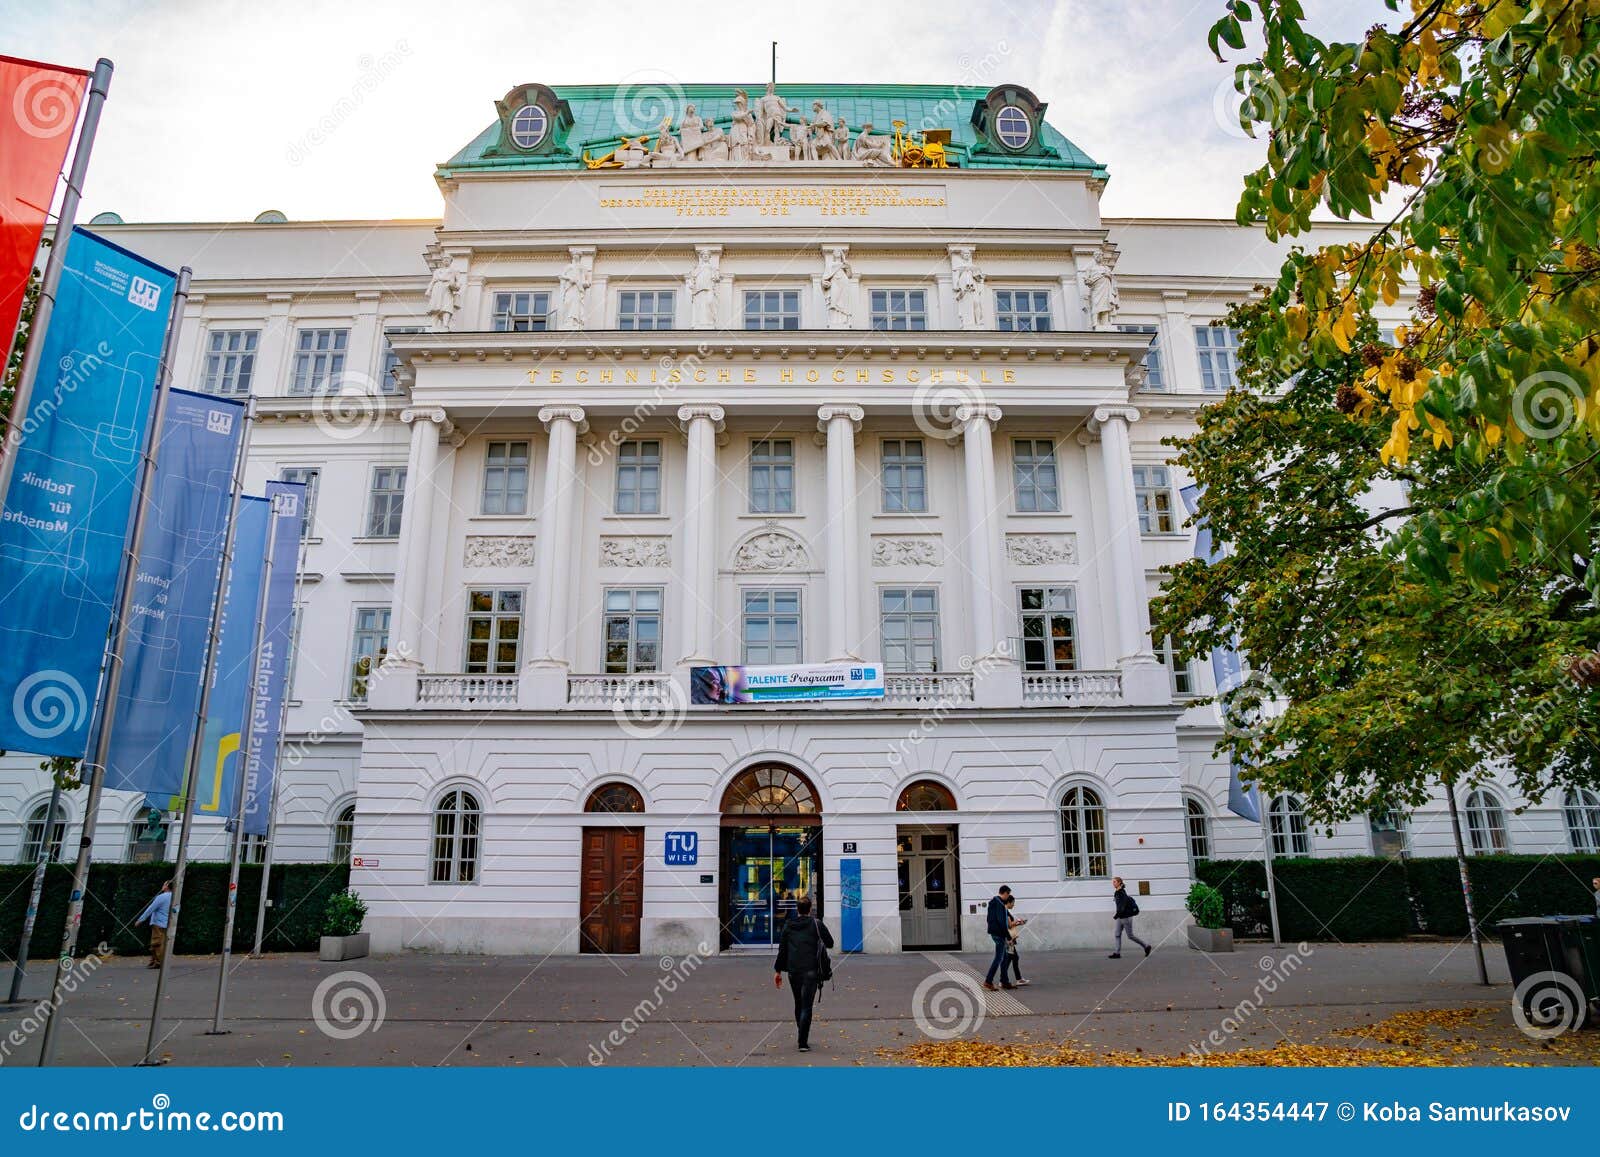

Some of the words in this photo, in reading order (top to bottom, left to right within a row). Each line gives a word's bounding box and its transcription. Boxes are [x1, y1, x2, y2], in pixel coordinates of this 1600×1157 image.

[676, 208, 730, 216] FRANZ
[760, 208, 790, 216] DER
[527, 368, 757, 384] TECHNISCHE
[780, 367, 1017, 384] HOCHSCHULE
[747, 675, 788, 685] TALENTE
[790, 672, 845, 684] Programm
[668, 834, 695, 851] TU
[668, 854, 695, 862] WIEN
